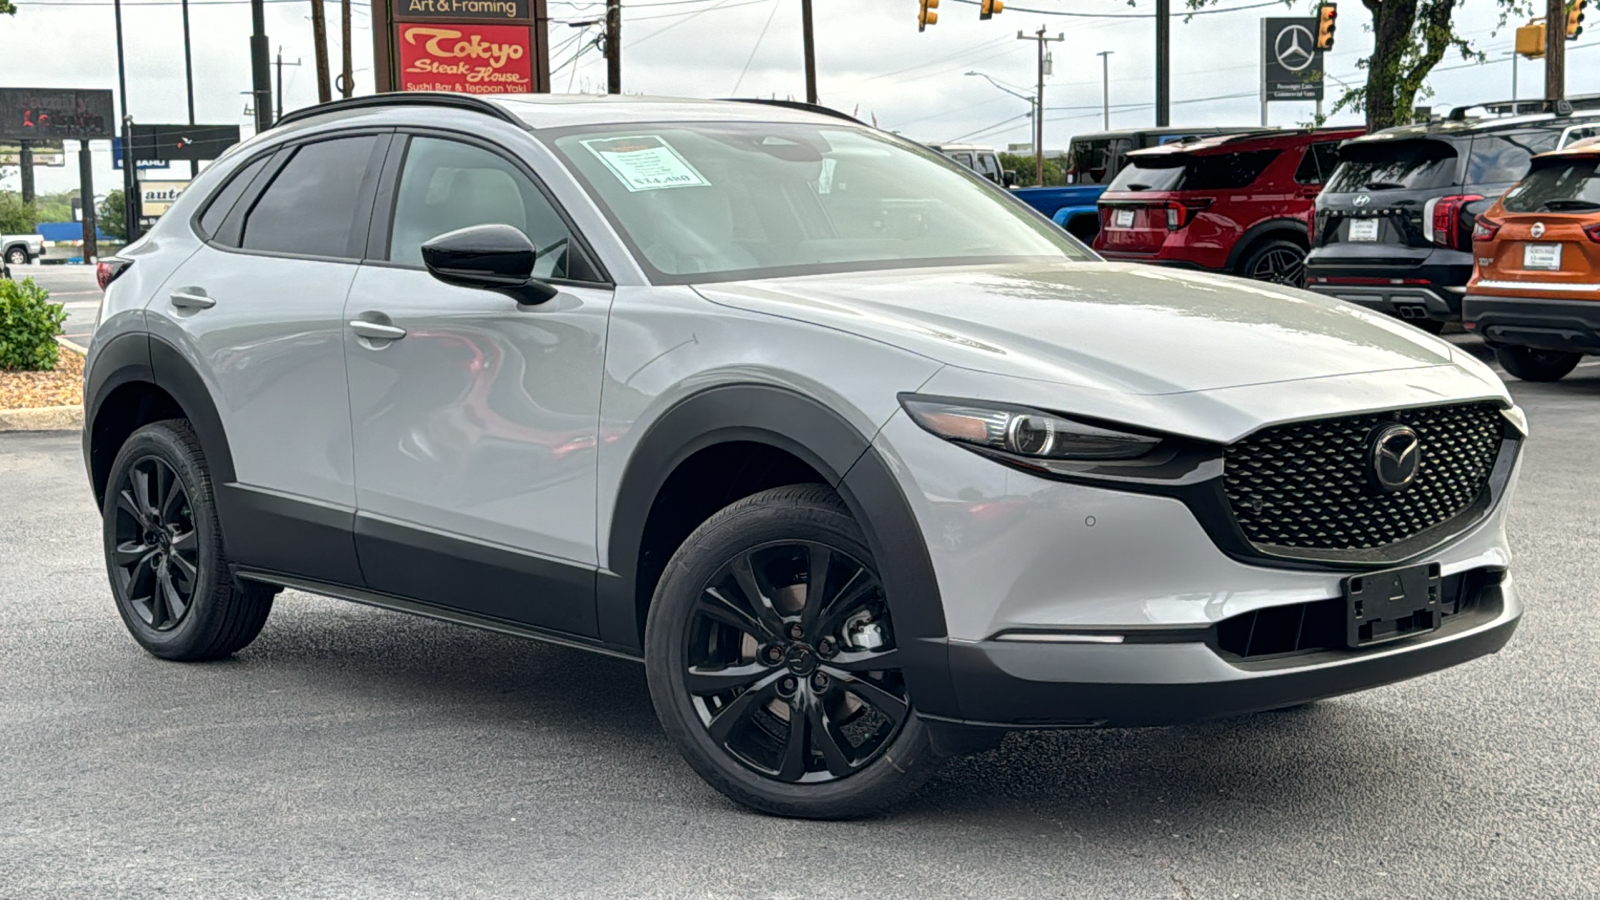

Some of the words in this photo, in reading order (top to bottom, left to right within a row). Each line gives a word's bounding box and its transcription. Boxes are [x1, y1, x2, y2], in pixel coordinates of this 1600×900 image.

[409, 0, 435, 12] Art
[437, 0, 450, 12] &
[453, 0, 517, 18] Framing
[404, 27, 524, 69] Tokyo
[405, 58, 470, 75] Steak
[466, 66, 529, 83] House
[407, 82, 433, 92] Sushi
[435, 83, 452, 92] Bar
[454, 83, 463, 92] &
[465, 83, 504, 93] Teppan
[506, 83, 527, 93] Yaki
